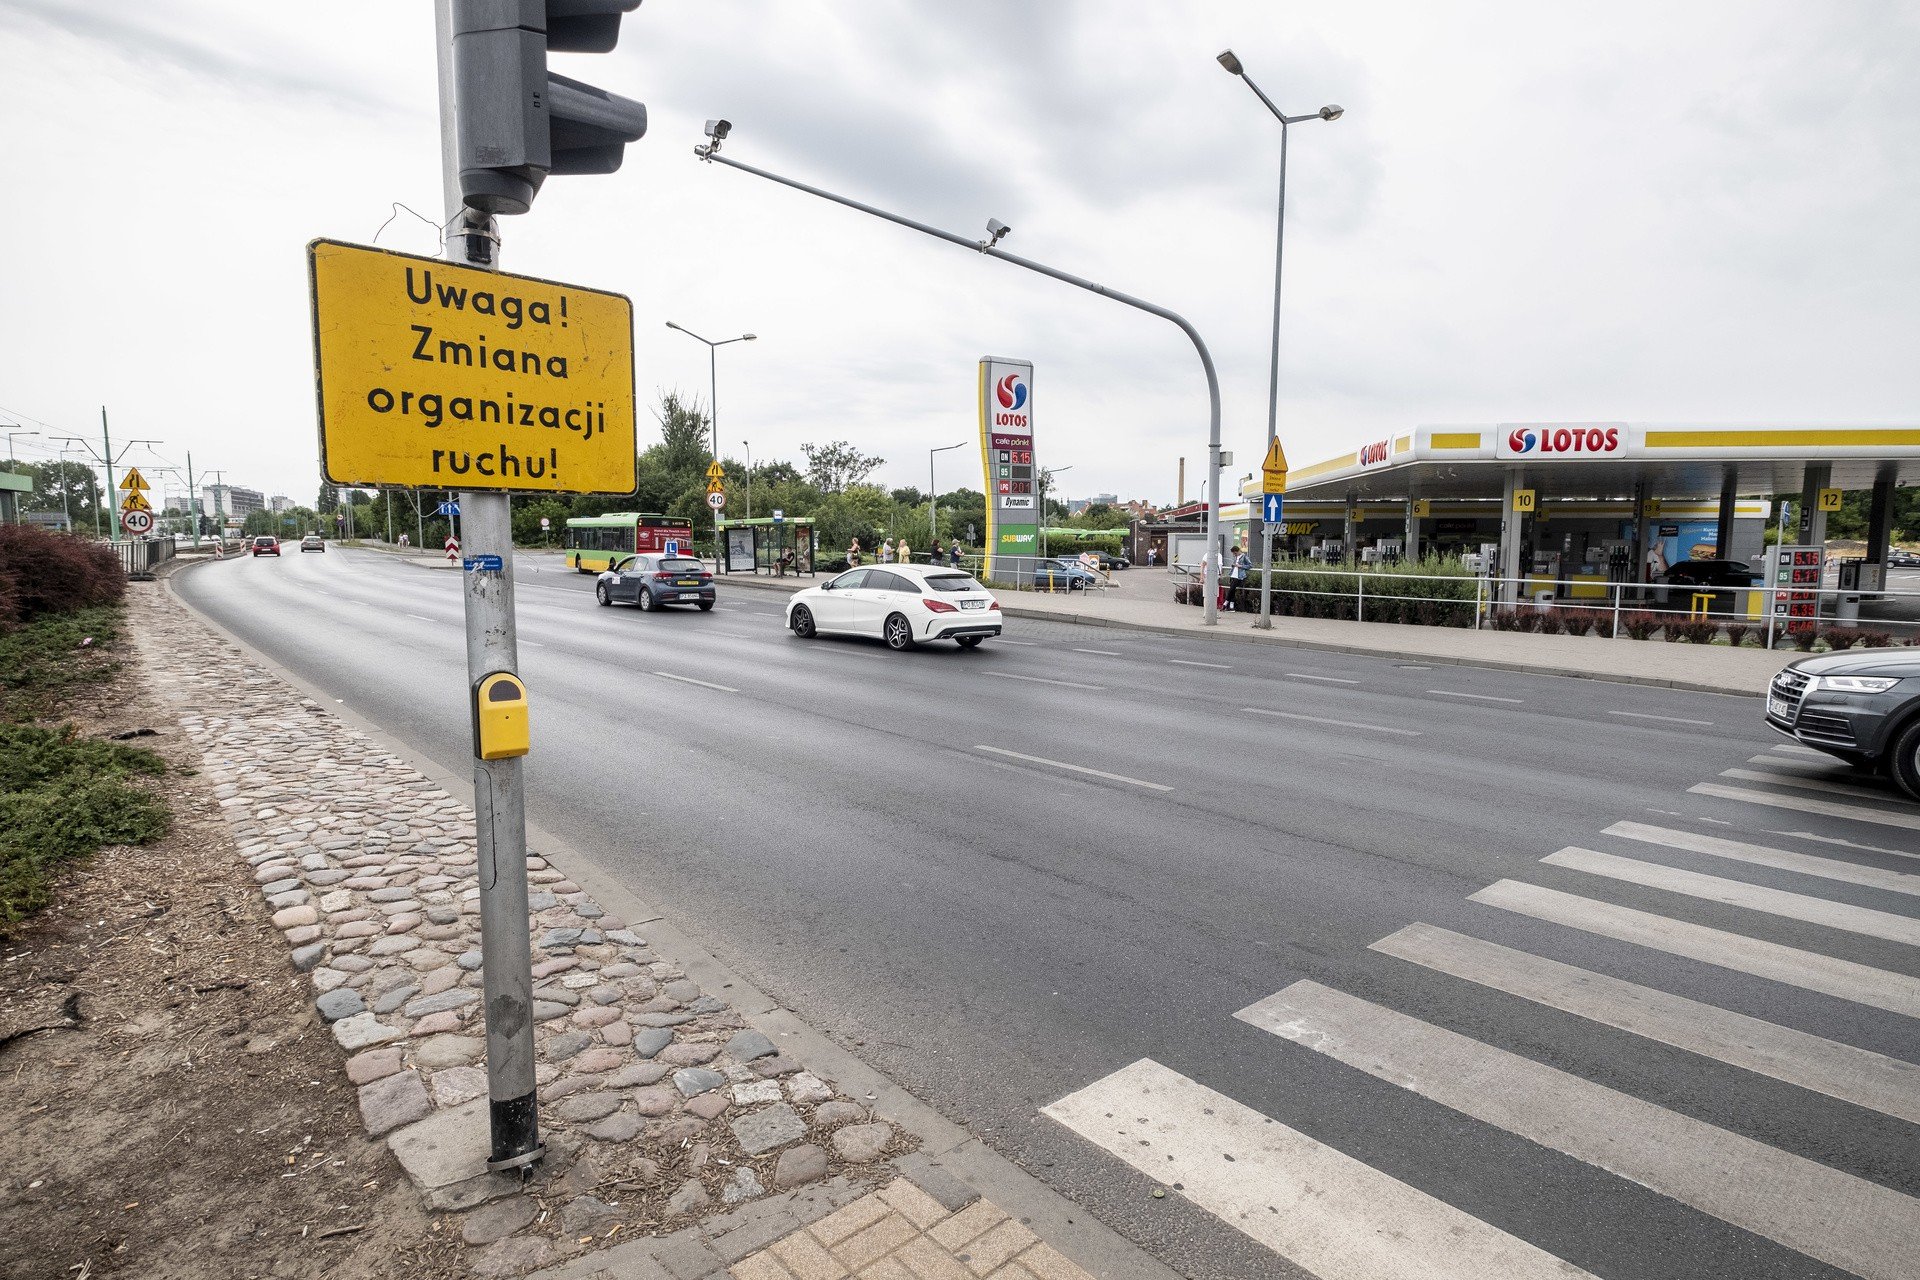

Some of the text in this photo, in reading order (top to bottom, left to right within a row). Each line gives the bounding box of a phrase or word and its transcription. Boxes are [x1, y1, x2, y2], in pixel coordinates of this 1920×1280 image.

[405, 267, 568, 329] Uwaga!
[410, 324, 568, 379] Zmiana
[367, 387, 605, 441] organizacji
[996, 413, 1027, 427] LOTOS
[1540, 428, 1618, 452] LOTOS
[1000, 452, 1030, 463] ON 5.15
[1367, 440, 1388, 464] LOTOS
[432, 444, 557, 479] ruchu!
[1001, 468, 1008, 476] 95
[1000, 483, 1009, 491] LPG
[709, 495, 723, 505] 40
[1005, 497, 1030, 507] Dynamic
[1518, 495, 1531, 506] 10
[1823, 494, 1838, 505] 12
[1414, 504, 1420, 513] 6
[127, 515, 148, 527] 40
[1261, 522, 1318, 535] UBWAY
[1002, 534, 1035, 543] SUBWAY
[1780, 552, 1819, 565] ON 5.15
[1779, 571, 1818, 582] 95 5.11
